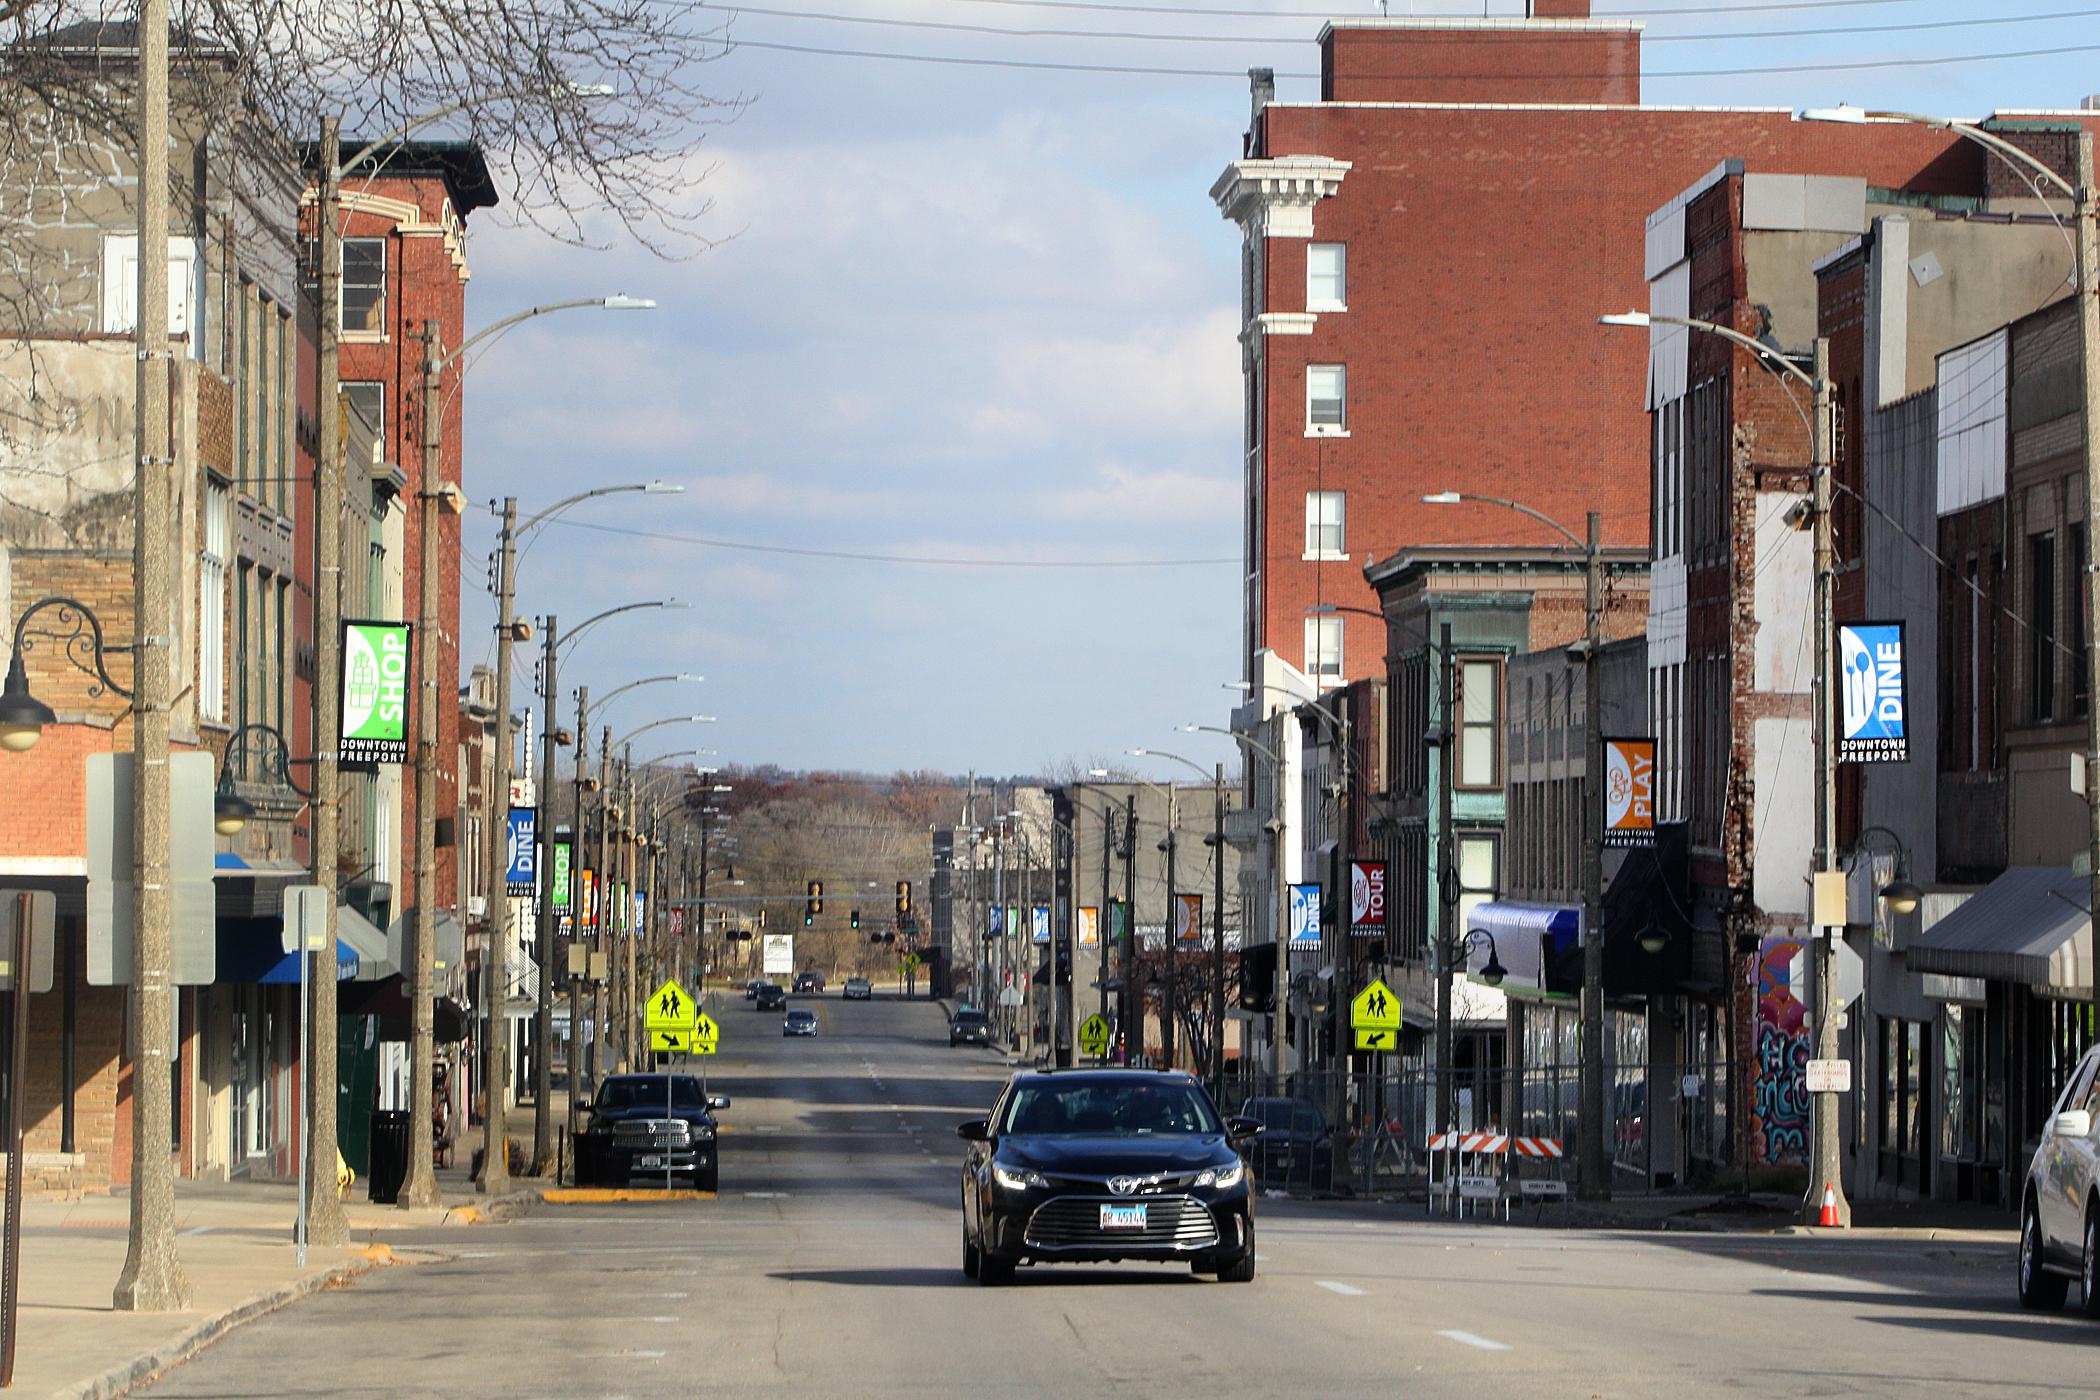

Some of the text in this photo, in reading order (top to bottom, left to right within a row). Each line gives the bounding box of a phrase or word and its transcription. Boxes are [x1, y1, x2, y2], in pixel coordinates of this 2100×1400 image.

[379, 632, 406, 722] SHOP
[1877, 642, 1903, 721] DINE
[340, 739, 406, 751] DOWNTOWN
[340, 751, 406, 763] FREEPORT
[1841, 739, 1906, 750] DOWNTOWN
[1841, 750, 1906, 762] FREEPORT
[1634, 753, 1652, 817] PLAY
[518, 820, 534, 872] DINE
[1604, 829, 1655, 837] DOWNTOWN
[1604, 838, 1655, 847] FREEPORT
[556, 847, 569, 897] SHOP
[1308, 893, 1320, 933] DINE
[1370, 869, 1384, 918] TOUR
